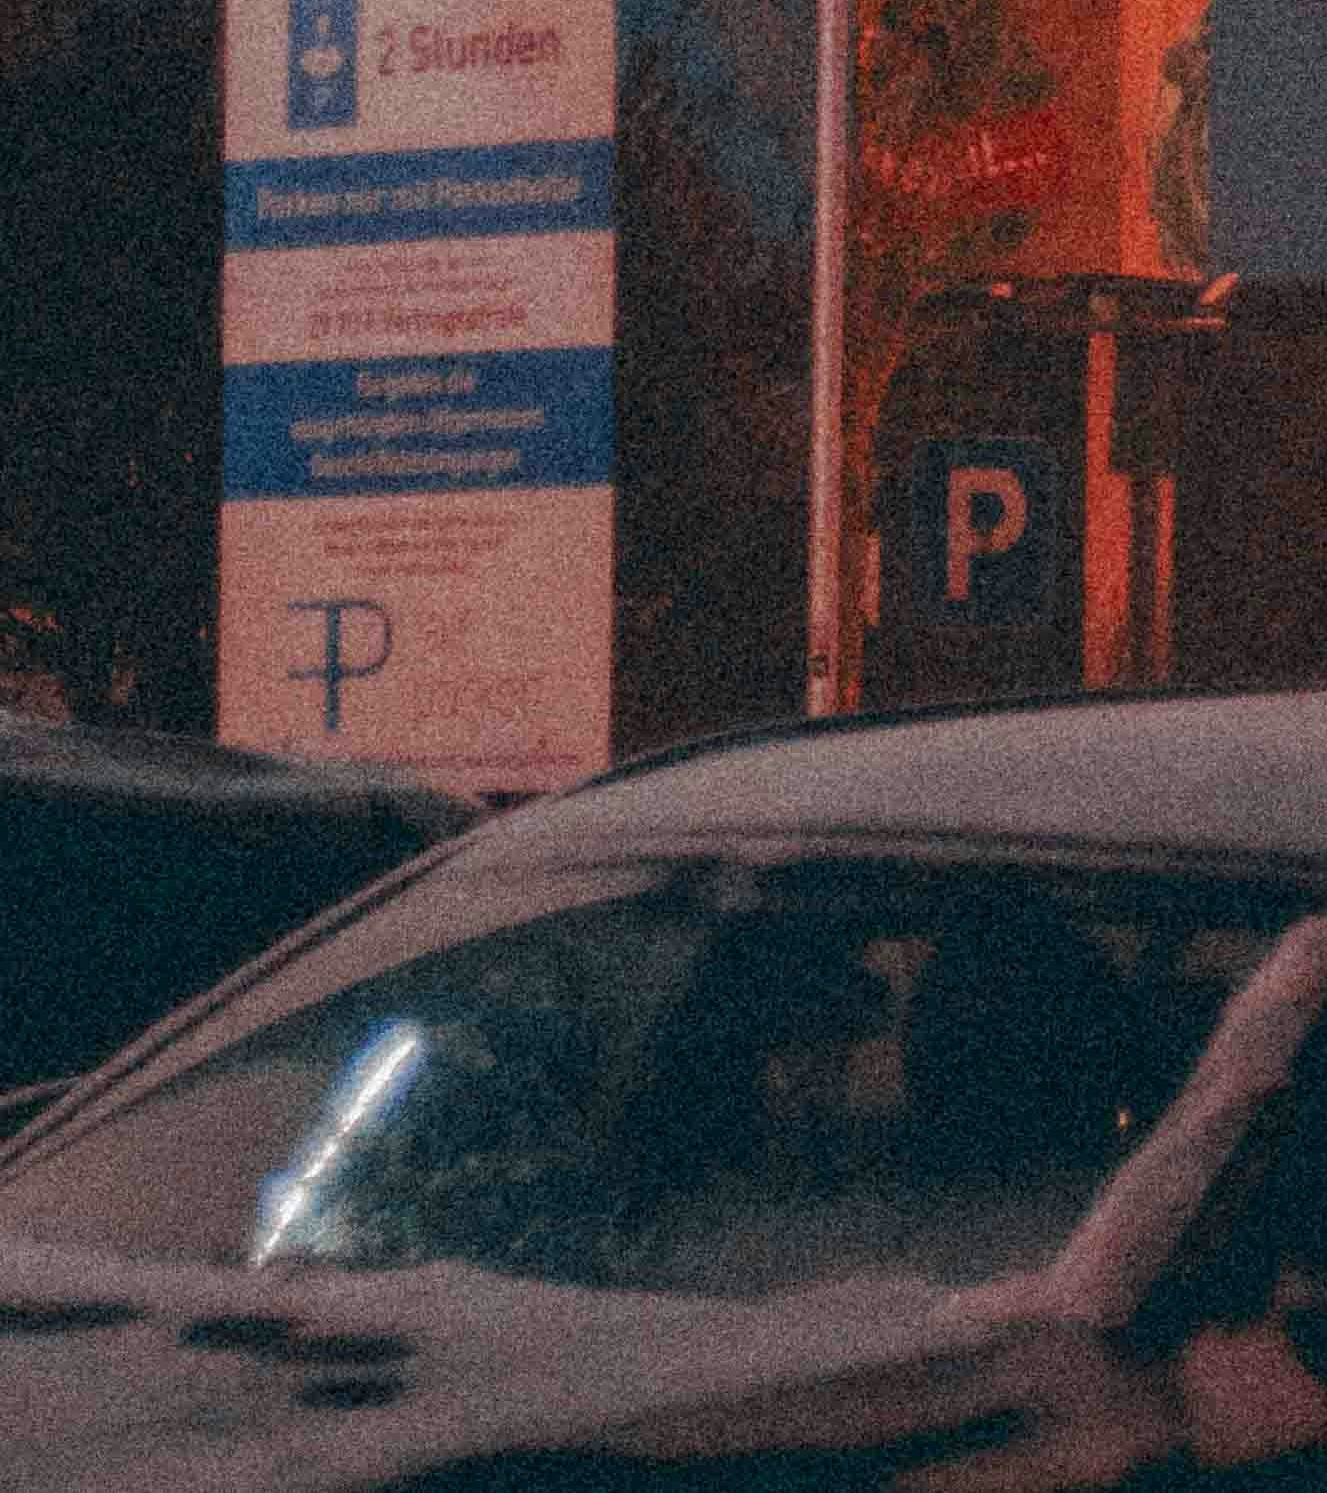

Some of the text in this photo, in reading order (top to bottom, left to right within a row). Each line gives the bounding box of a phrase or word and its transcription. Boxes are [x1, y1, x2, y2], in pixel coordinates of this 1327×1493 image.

[409, 18, 562, 72] Stunden
[946, 467, 1026, 601] P
[286, 598, 394, 730] P
